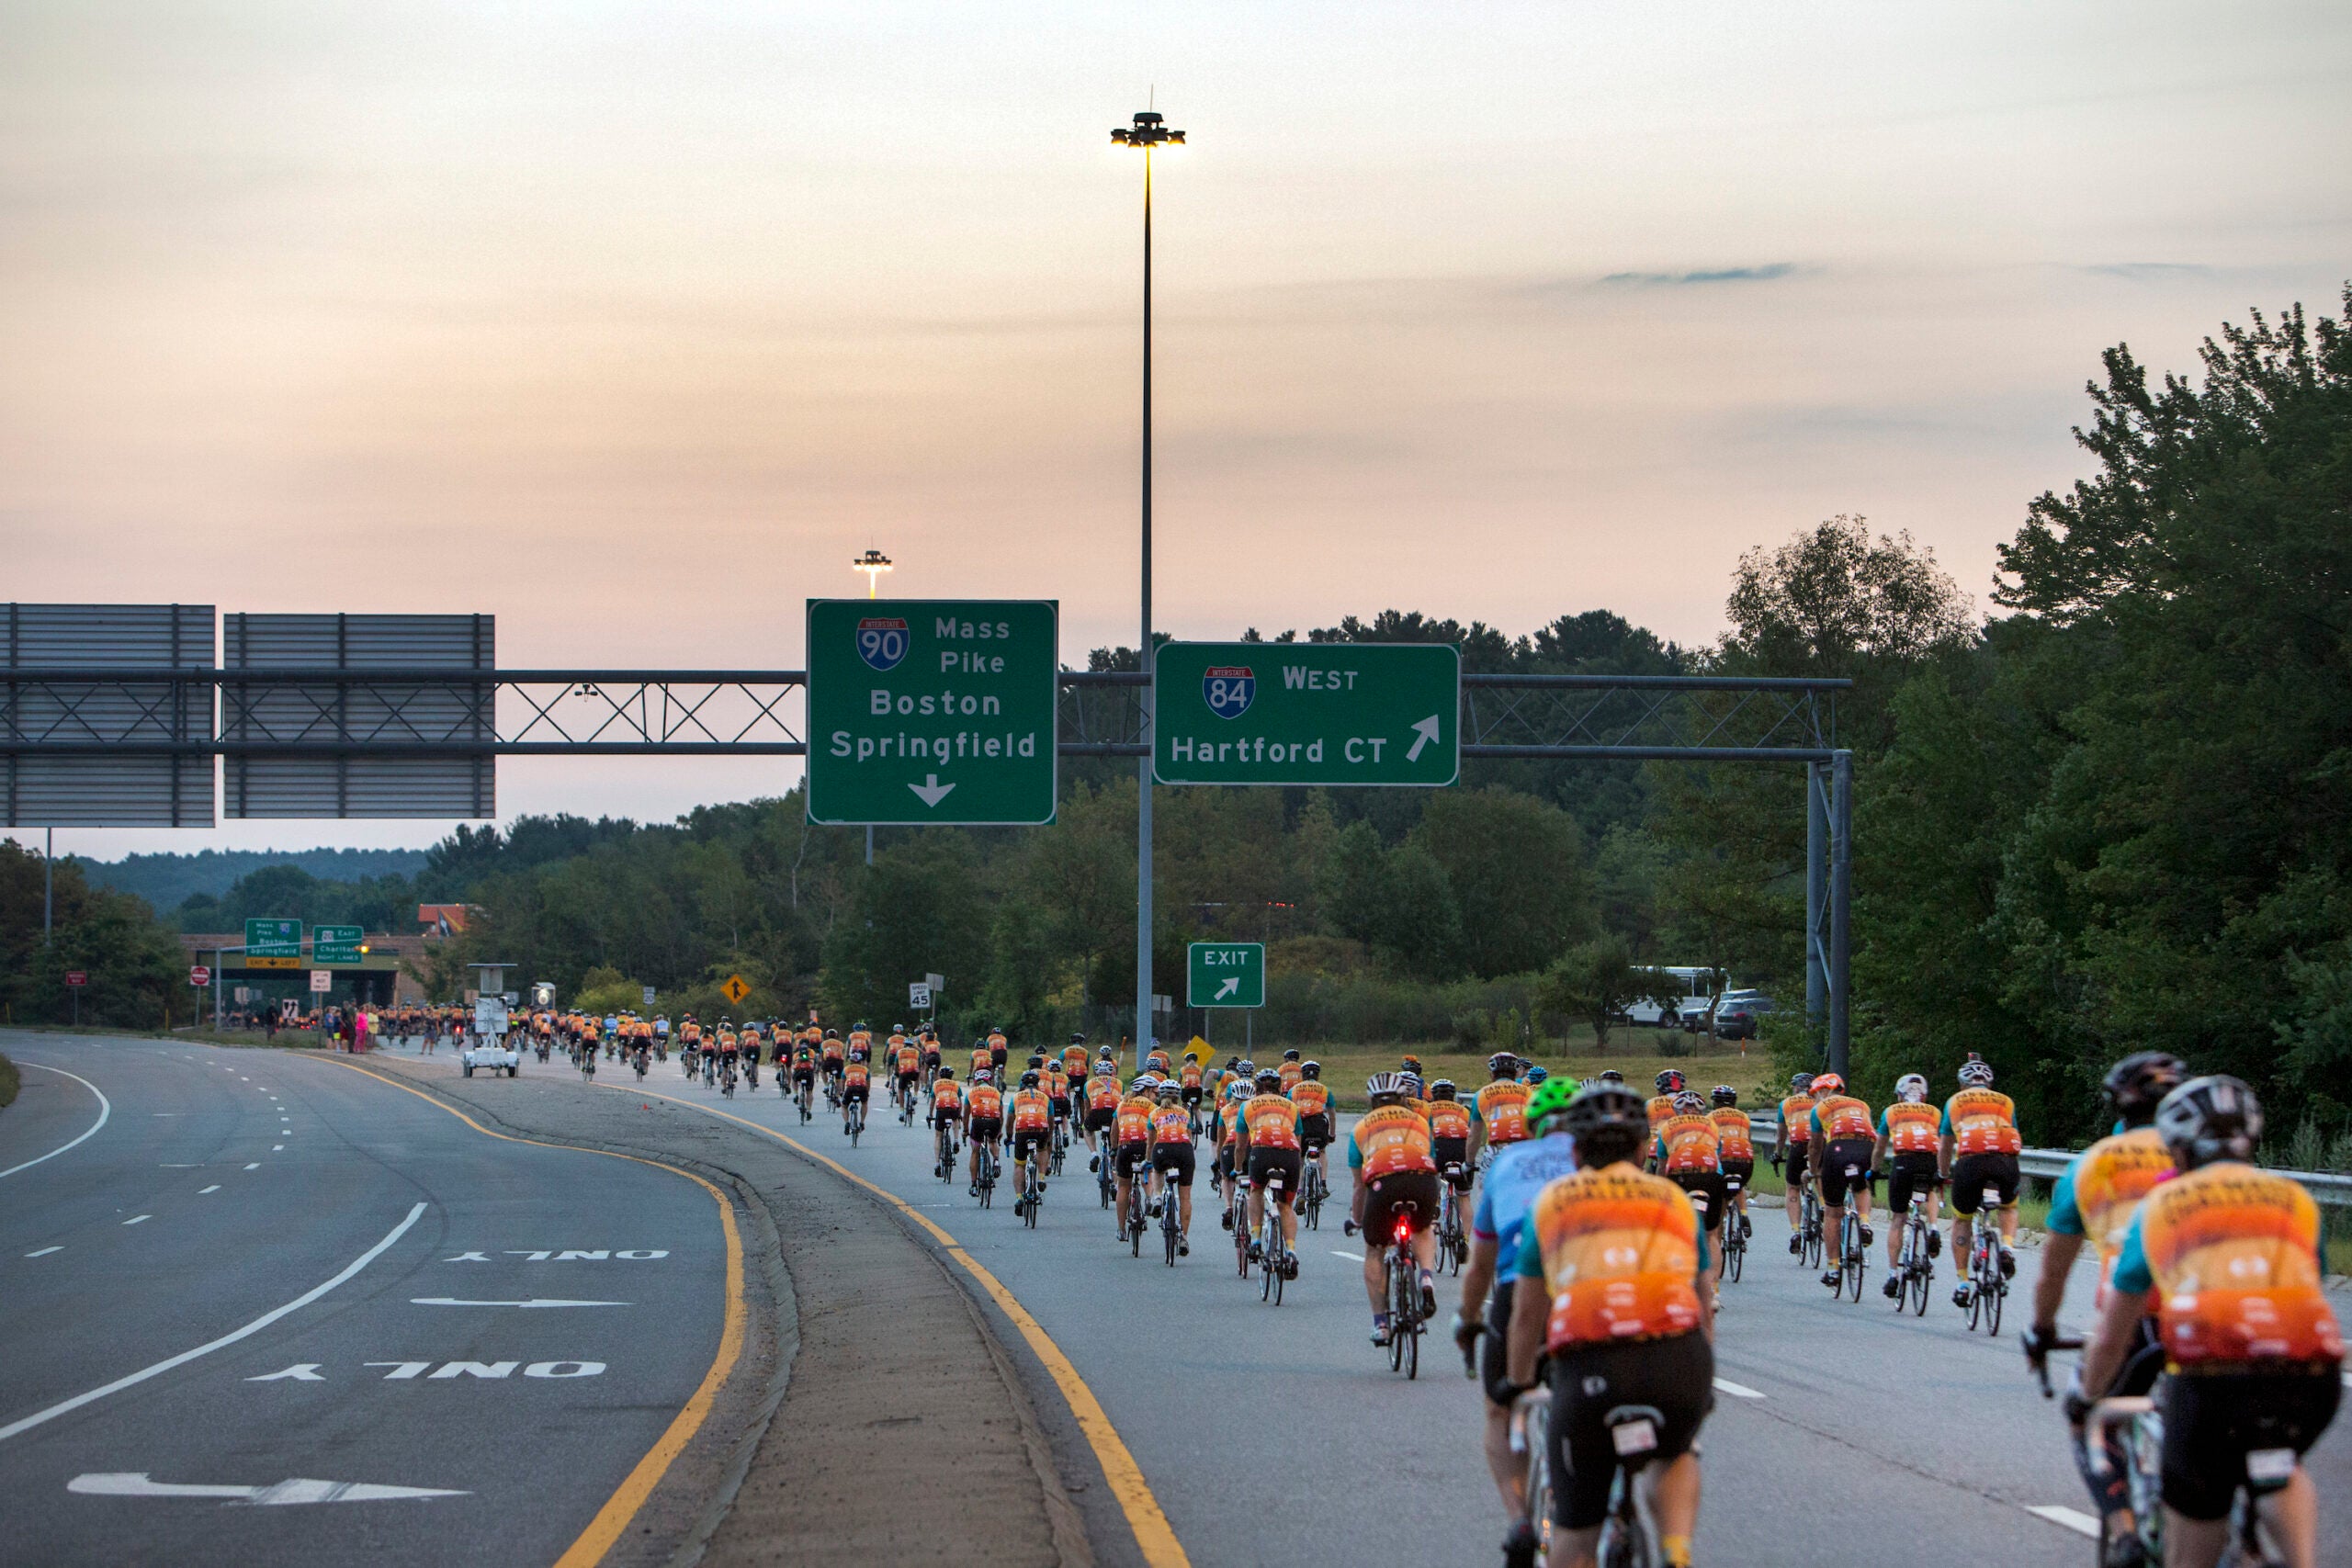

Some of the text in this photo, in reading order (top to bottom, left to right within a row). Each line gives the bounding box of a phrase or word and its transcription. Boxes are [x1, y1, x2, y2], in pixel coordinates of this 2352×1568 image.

[865, 620, 899, 628] INTERSTATE
[935, 616, 1010, 639] Mass
[861, 630, 902, 660] 90
[941, 651, 1005, 673] Pike
[1212, 669, 1246, 677] INTERSTATE
[1283, 665, 1358, 691] WEST
[870, 689, 1001, 716] Boston
[1209, 679, 1247, 708] 84
[830, 730, 1035, 766] Springfield
[1171, 737, 1387, 763] Hartford CT
[1204, 951, 1249, 965] EXIT
[911, 995, 928, 1005] 45
[443, 1250, 670, 1261] ONLY
[244, 1361, 607, 1381] ONLY
